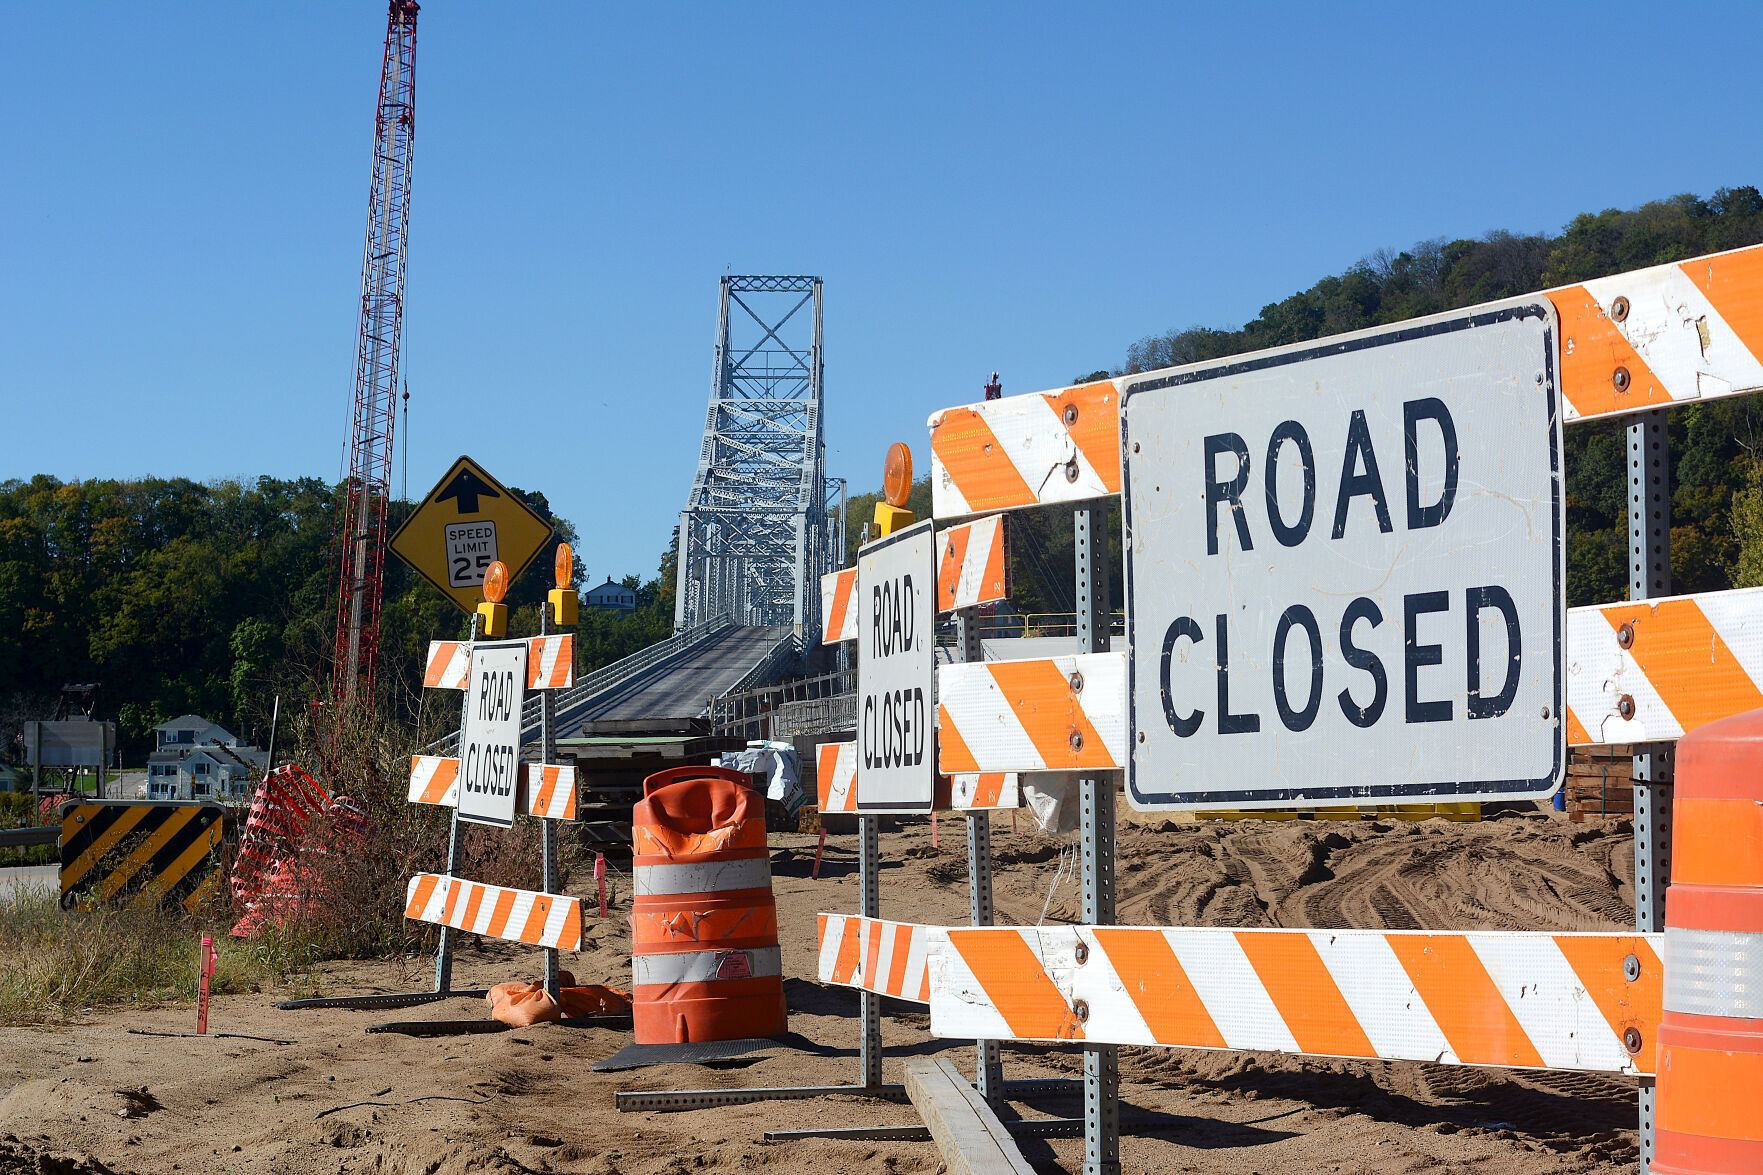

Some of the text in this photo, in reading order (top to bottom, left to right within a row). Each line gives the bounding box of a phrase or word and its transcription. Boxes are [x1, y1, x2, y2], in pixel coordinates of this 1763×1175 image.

[1204, 397, 1459, 555] ROAD
[449, 527, 493, 541] SPEED
[454, 541, 489, 554] LIMIT
[452, 554, 491, 581] 25
[873, 574, 914, 659] ROAD
[1160, 585, 1522, 738] CLOSED
[478, 670, 513, 722] ROAD
[864, 687, 925, 770] CLOSED
[466, 742, 514, 797] CLOSED
